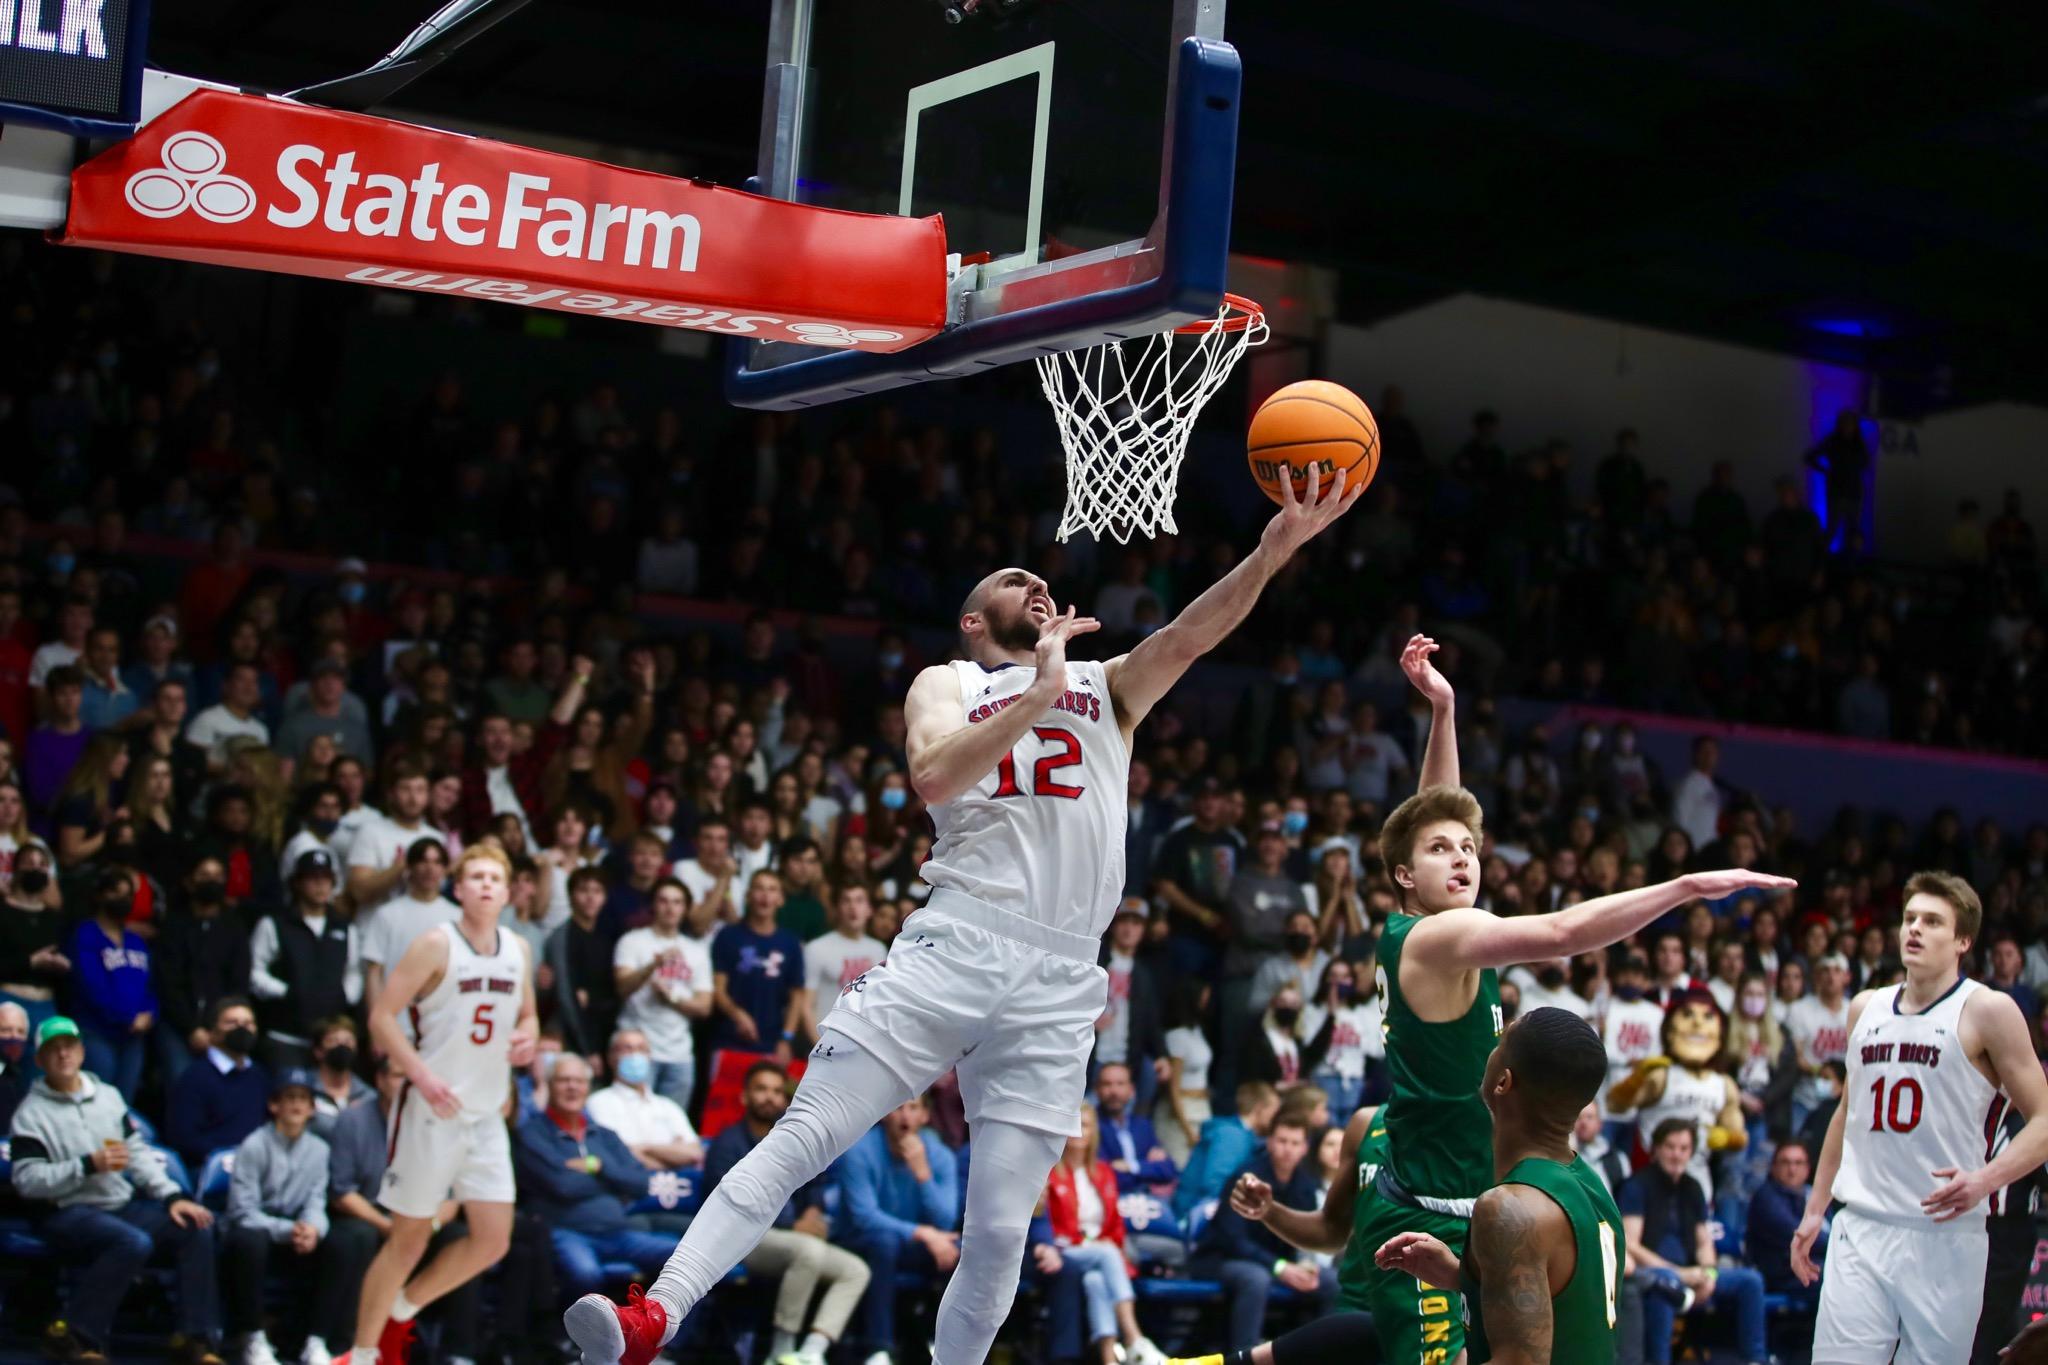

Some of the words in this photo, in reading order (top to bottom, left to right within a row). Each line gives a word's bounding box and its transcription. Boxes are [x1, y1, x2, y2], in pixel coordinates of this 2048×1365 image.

[1050, 689, 1101, 723] ARY'S
[988, 727, 1086, 800] 12
[470, 1004, 496, 1047] 5
[1860, 1043, 1895, 1066] SAINT
[1869, 1076, 1924, 1134] 10
